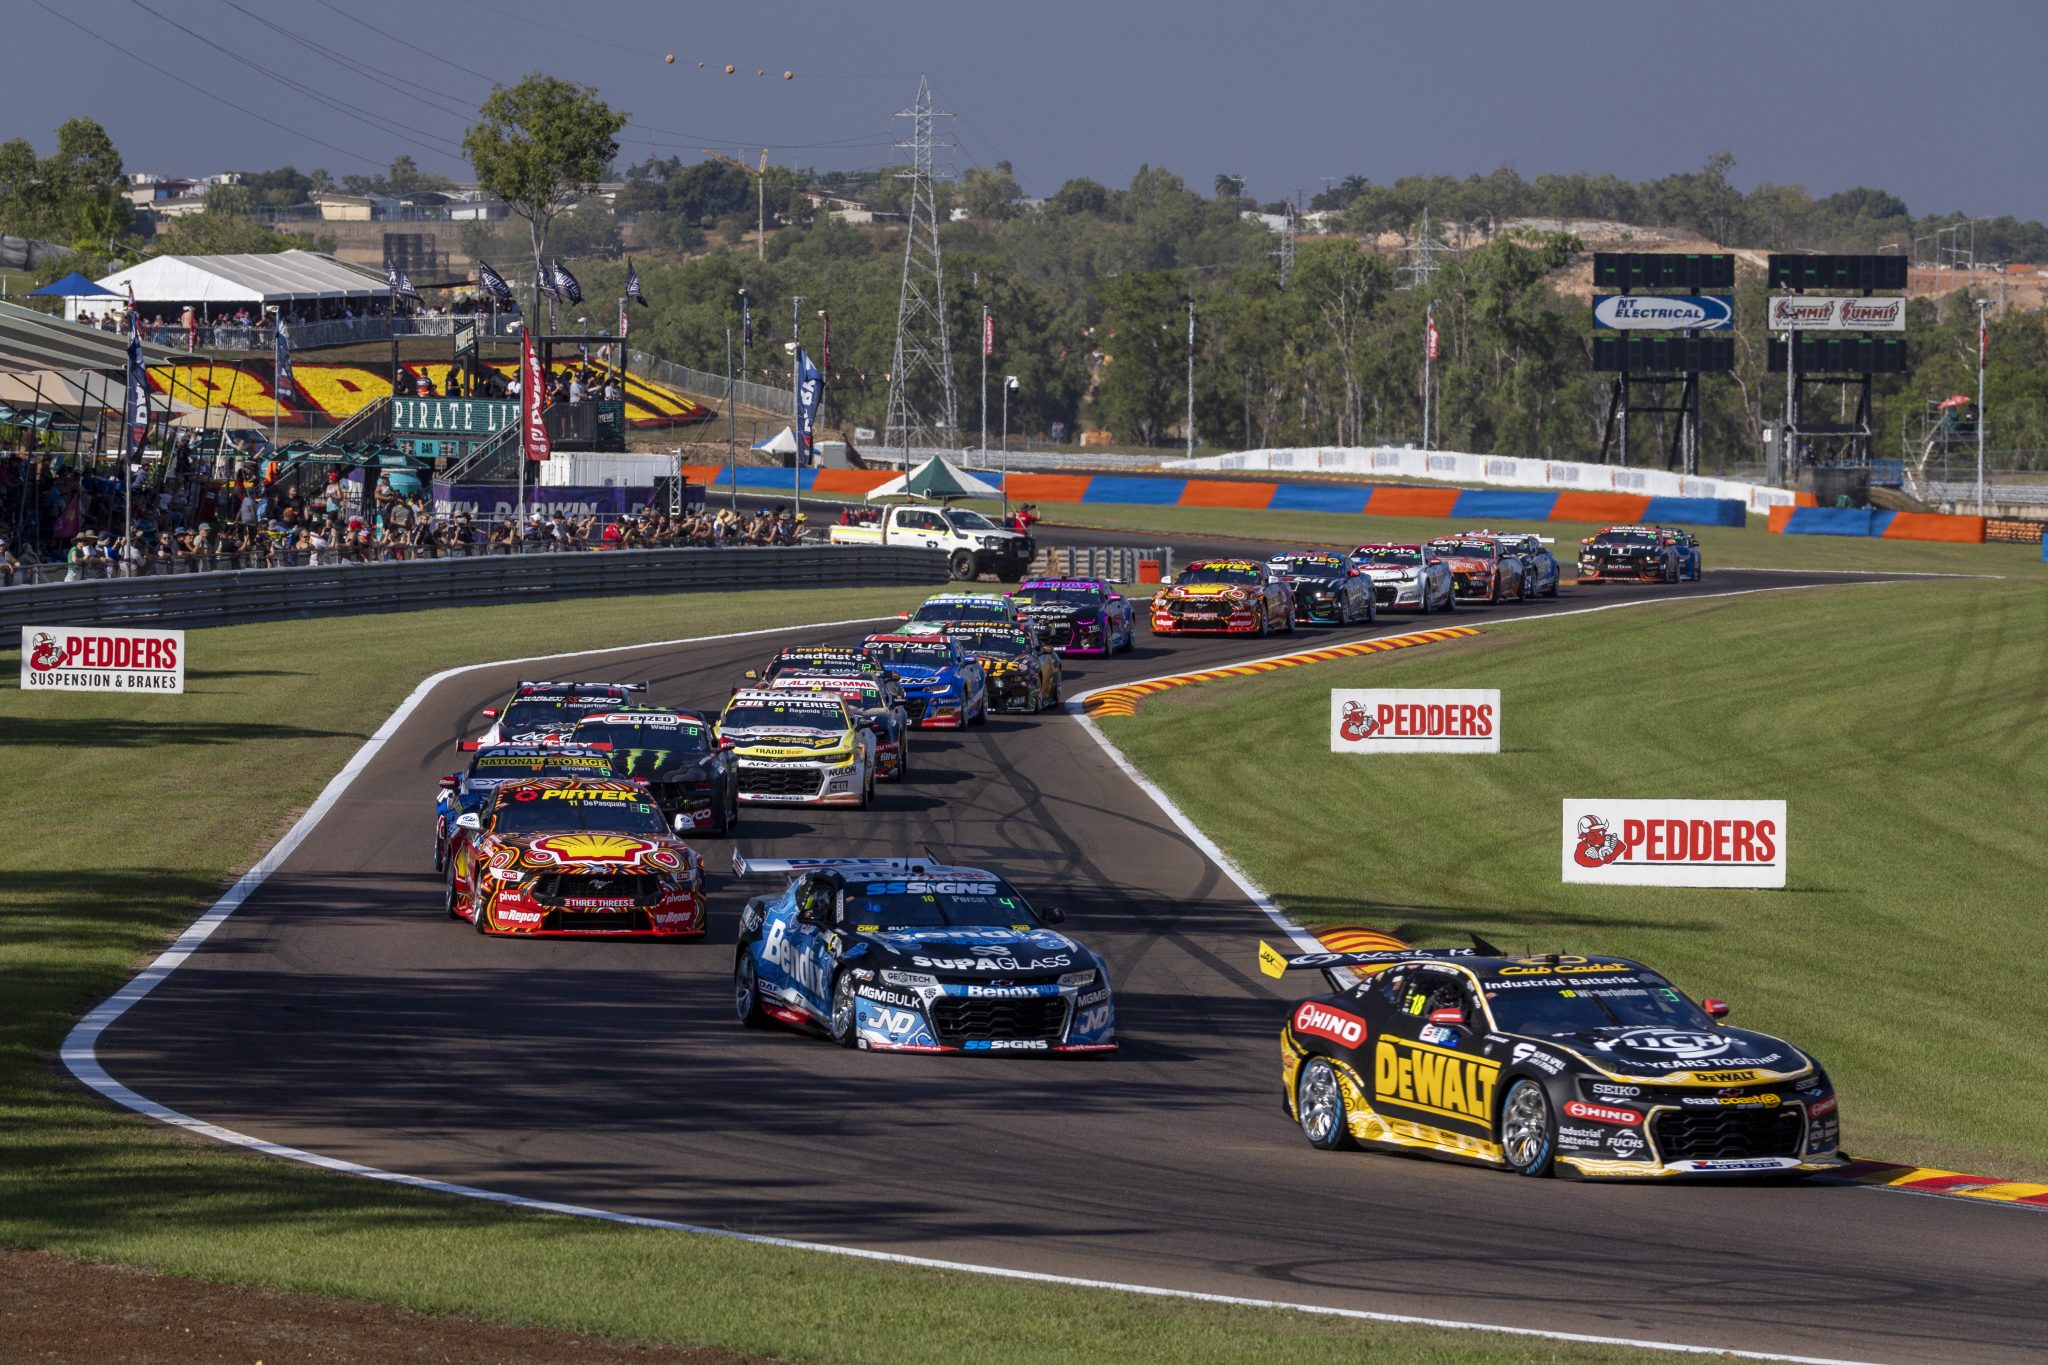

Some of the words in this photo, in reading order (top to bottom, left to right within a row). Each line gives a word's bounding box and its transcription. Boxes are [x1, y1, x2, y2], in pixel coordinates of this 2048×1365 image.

[1617, 299, 1638, 308] NT
[1615, 309, 1701, 318] ELECTRICAL
[395, 401, 473, 430] PIRATE
[488, 404, 520, 431] LIF
[1360, 547, 1416, 555] Kubota
[66, 636, 177, 669] PEDDERS
[30, 672, 110, 687] SUSPENSION
[115, 675, 123, 688] &
[128, 675, 176, 689] BRAKES
[788, 680, 876, 688] ALFAGOMMA
[1377, 703, 1493, 737] PEDDERS
[485, 749, 603, 757] AMPOL
[547, 758, 607, 766] STORAGE
[829, 766, 856, 777] NULON
[542, 789, 638, 801] PIRTEK
[685, 809, 712, 820] YCO
[1623, 819, 1776, 862] PEDDERS
[571, 899, 597, 907] THREE
[598, 899, 629, 907] THREES
[999, 898, 1016, 909] 4
[508, 909, 541, 923] Repco
[762, 919, 827, 1001] Bendix
[912, 954, 1071, 971] SUPAGLASS
[1261, 952, 1275, 965] JAX
[1498, 965, 1552, 975] Cub
[1554, 962, 1634, 973] Cadet
[759, 981, 779, 992] DAF
[1485, 978, 1562, 989] Industrial
[1567, 976, 1639, 986] Batteries
[968, 985, 1040, 999] Bendix
[1558, 989, 1576, 998] 18
[1410, 994, 1426, 1016] 18
[1310, 1011, 1362, 1042] HINO
[1646, 1058, 1711, 1070] YEARS
[1709, 1053, 1782, 1067] TOGETHER
[1592, 1083, 1641, 1097] SEIKO
[1585, 1108, 1636, 1122] HINO
[1559, 1126, 1602, 1138] Industrial
[1558, 1135, 1600, 1147] Batteries
[1606, 1137, 1644, 1149] FUCHS
